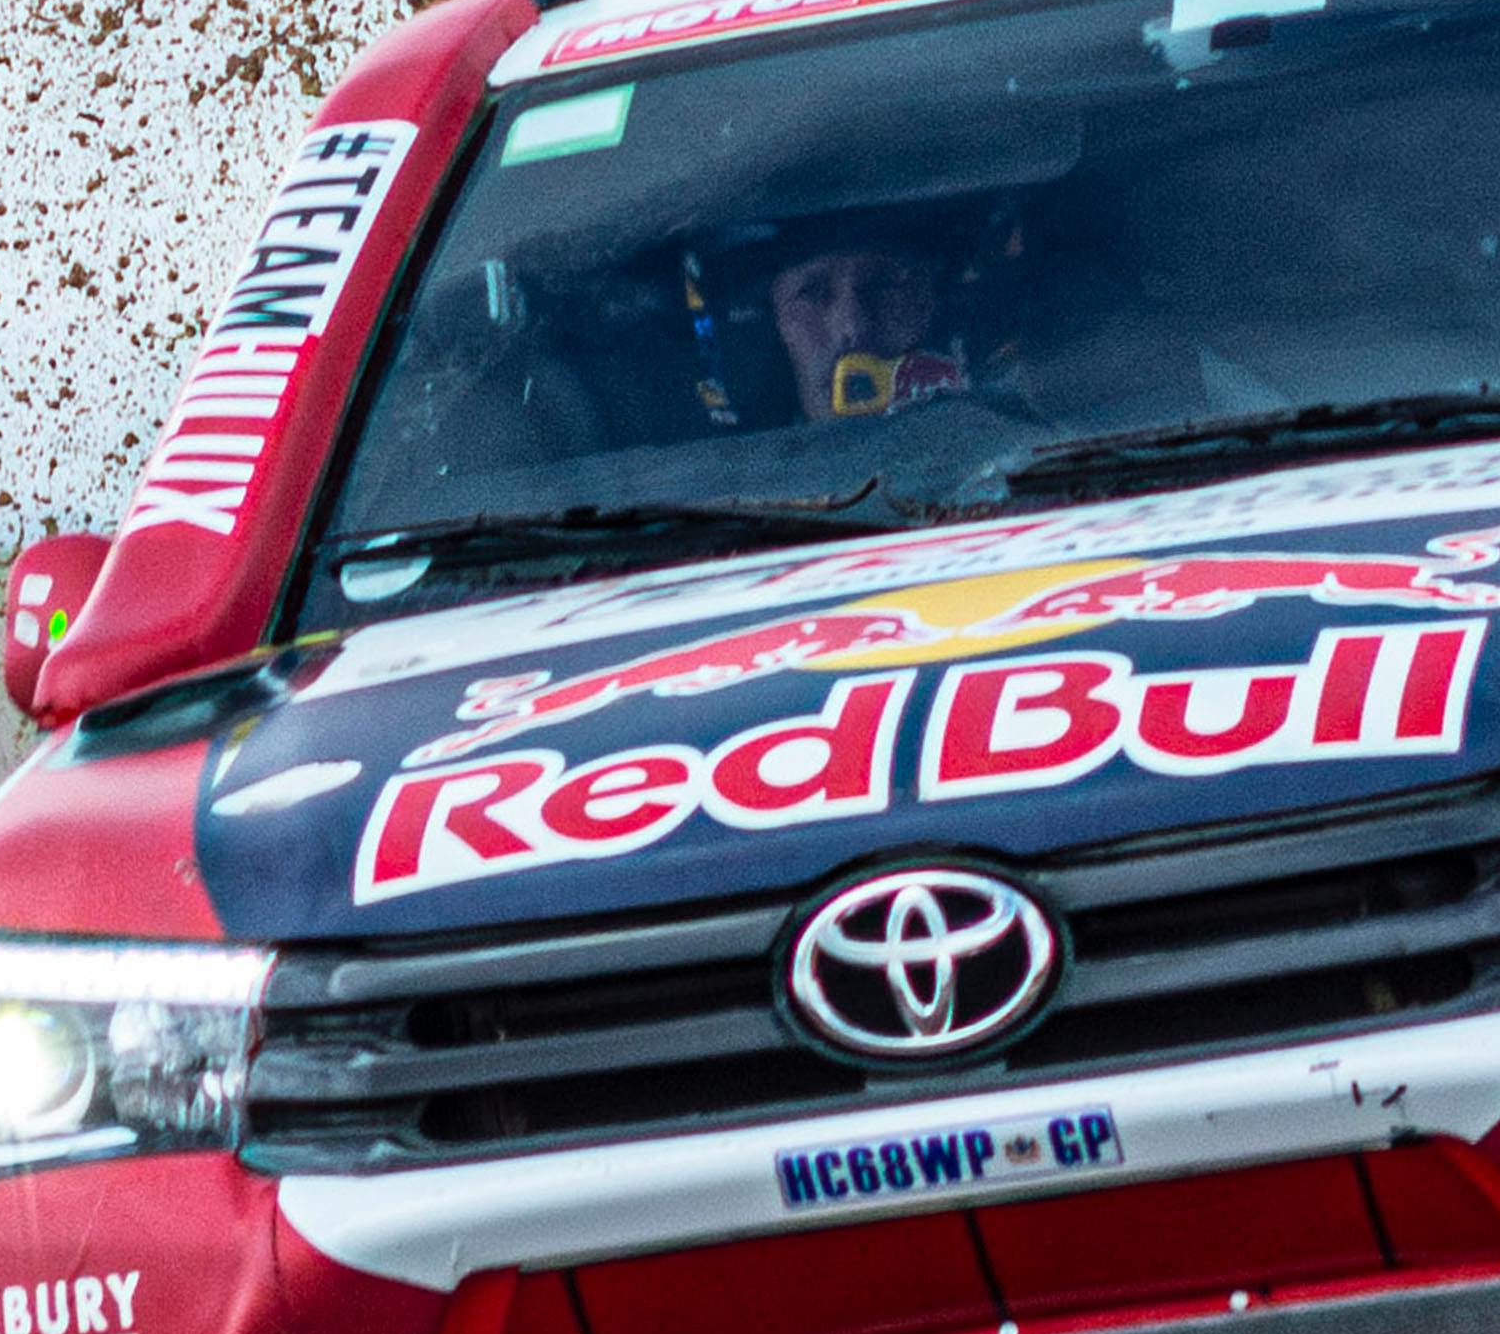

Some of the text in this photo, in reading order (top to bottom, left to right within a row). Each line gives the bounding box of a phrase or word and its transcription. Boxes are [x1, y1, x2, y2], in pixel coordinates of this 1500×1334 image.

[118, 129, 396, 537] #TEAMHILUX
[354, 618, 1488, 905] Red Bull
[1047, 1113, 1112, 1167] GP
